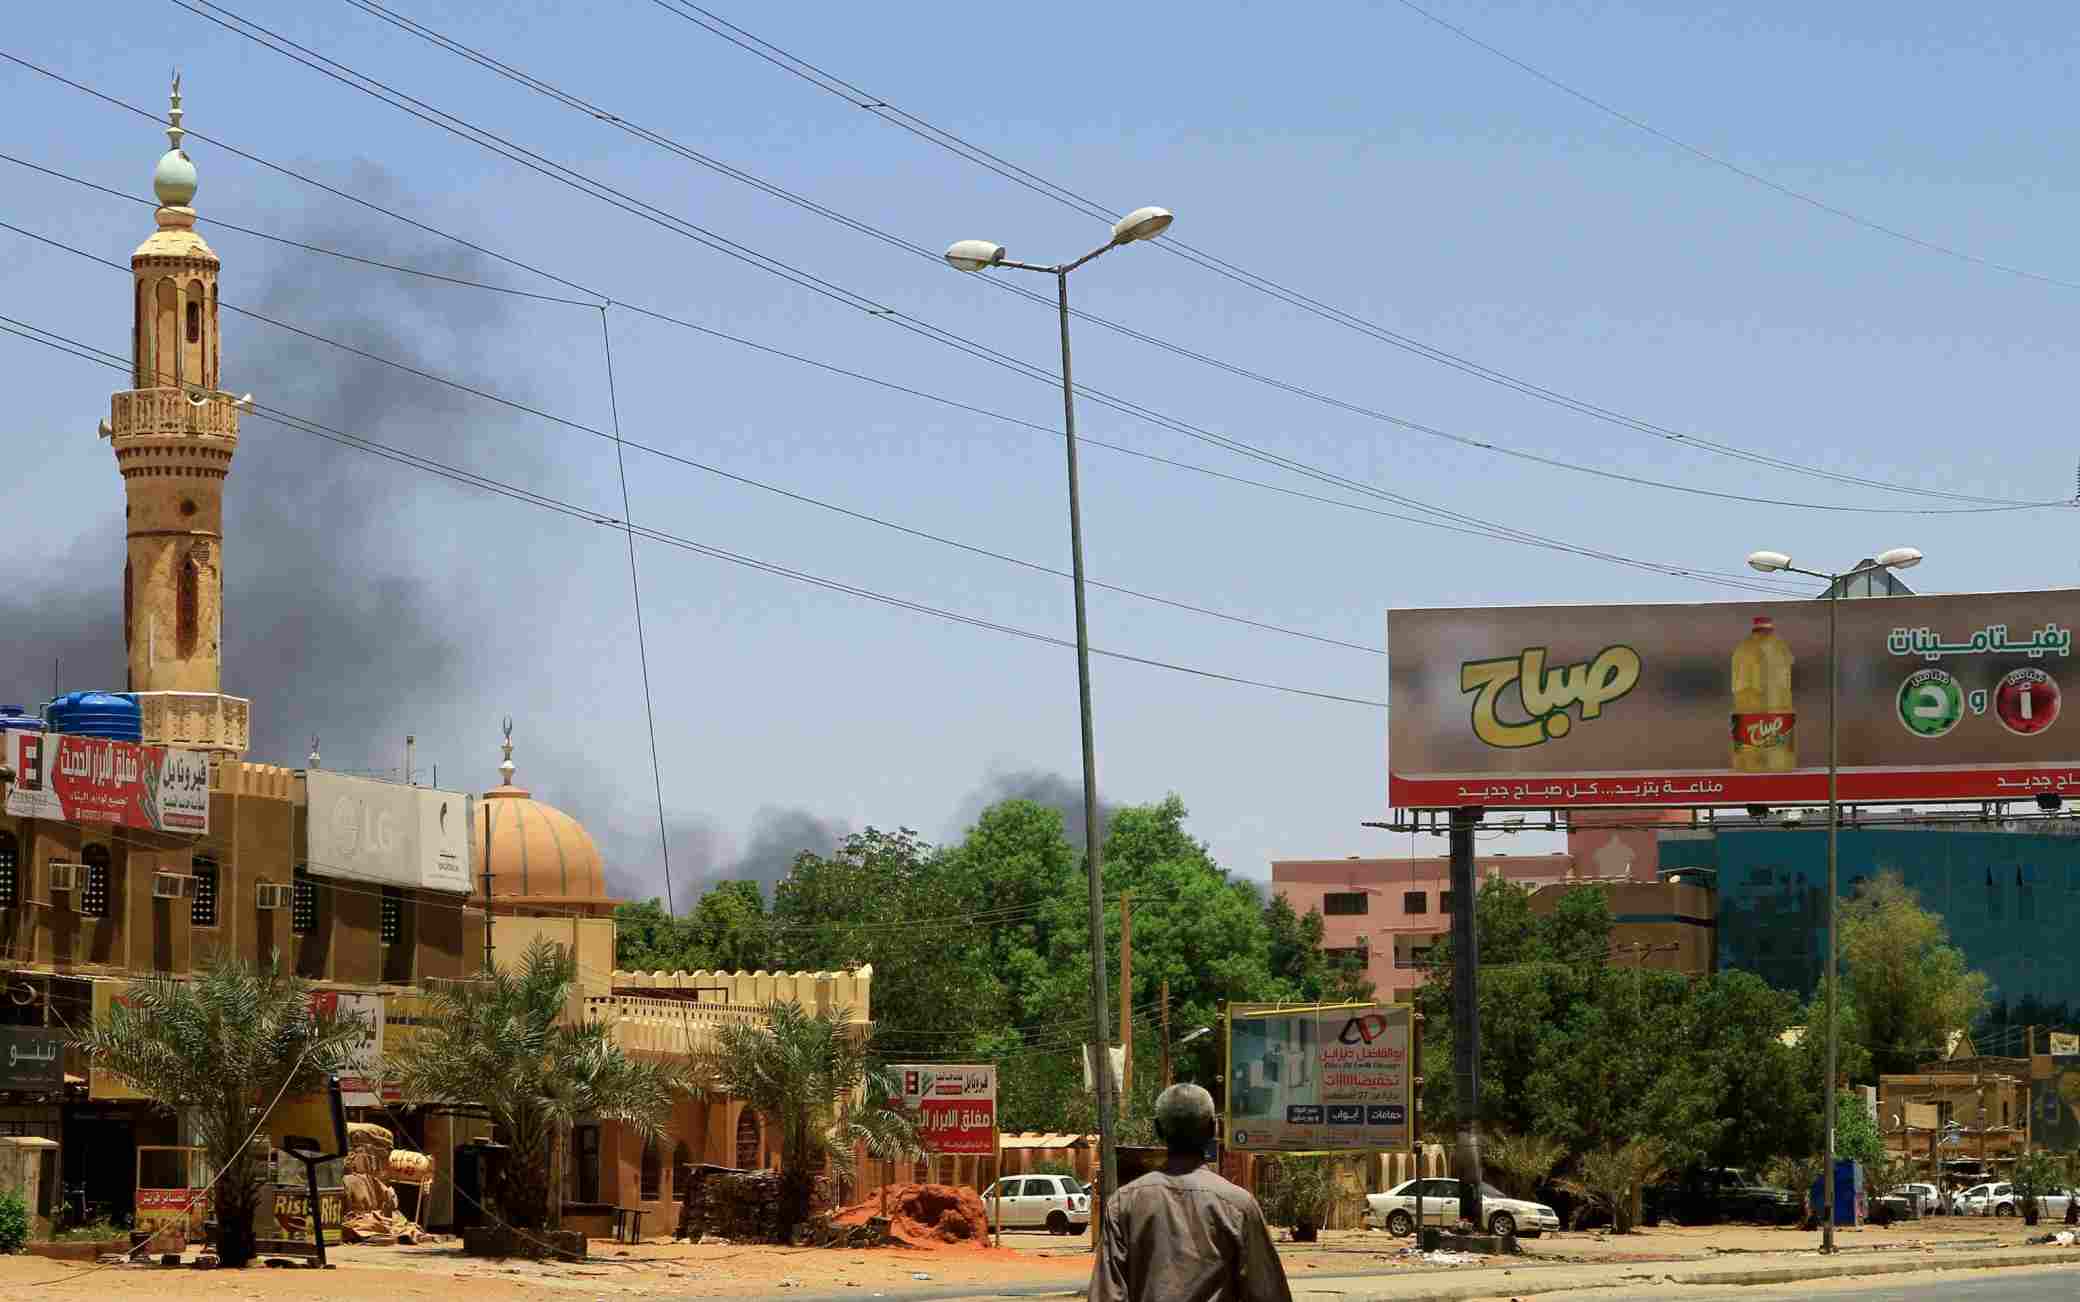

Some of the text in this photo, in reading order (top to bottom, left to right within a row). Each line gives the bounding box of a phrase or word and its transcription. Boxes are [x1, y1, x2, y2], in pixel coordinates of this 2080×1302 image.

[1887, 623, 2071, 661] بفيتامينات
[1460, 644, 1641, 749] صباح
[1968, 688, 1988, 715] و
[1566, 782, 1598, 799] كل
[1662, 780, 1723, 794] مناعة
[1996, 775, 2054, 790] جديد
[1458, 785, 1509, 800] جديد
[1513, 783, 1562, 800] صباح
